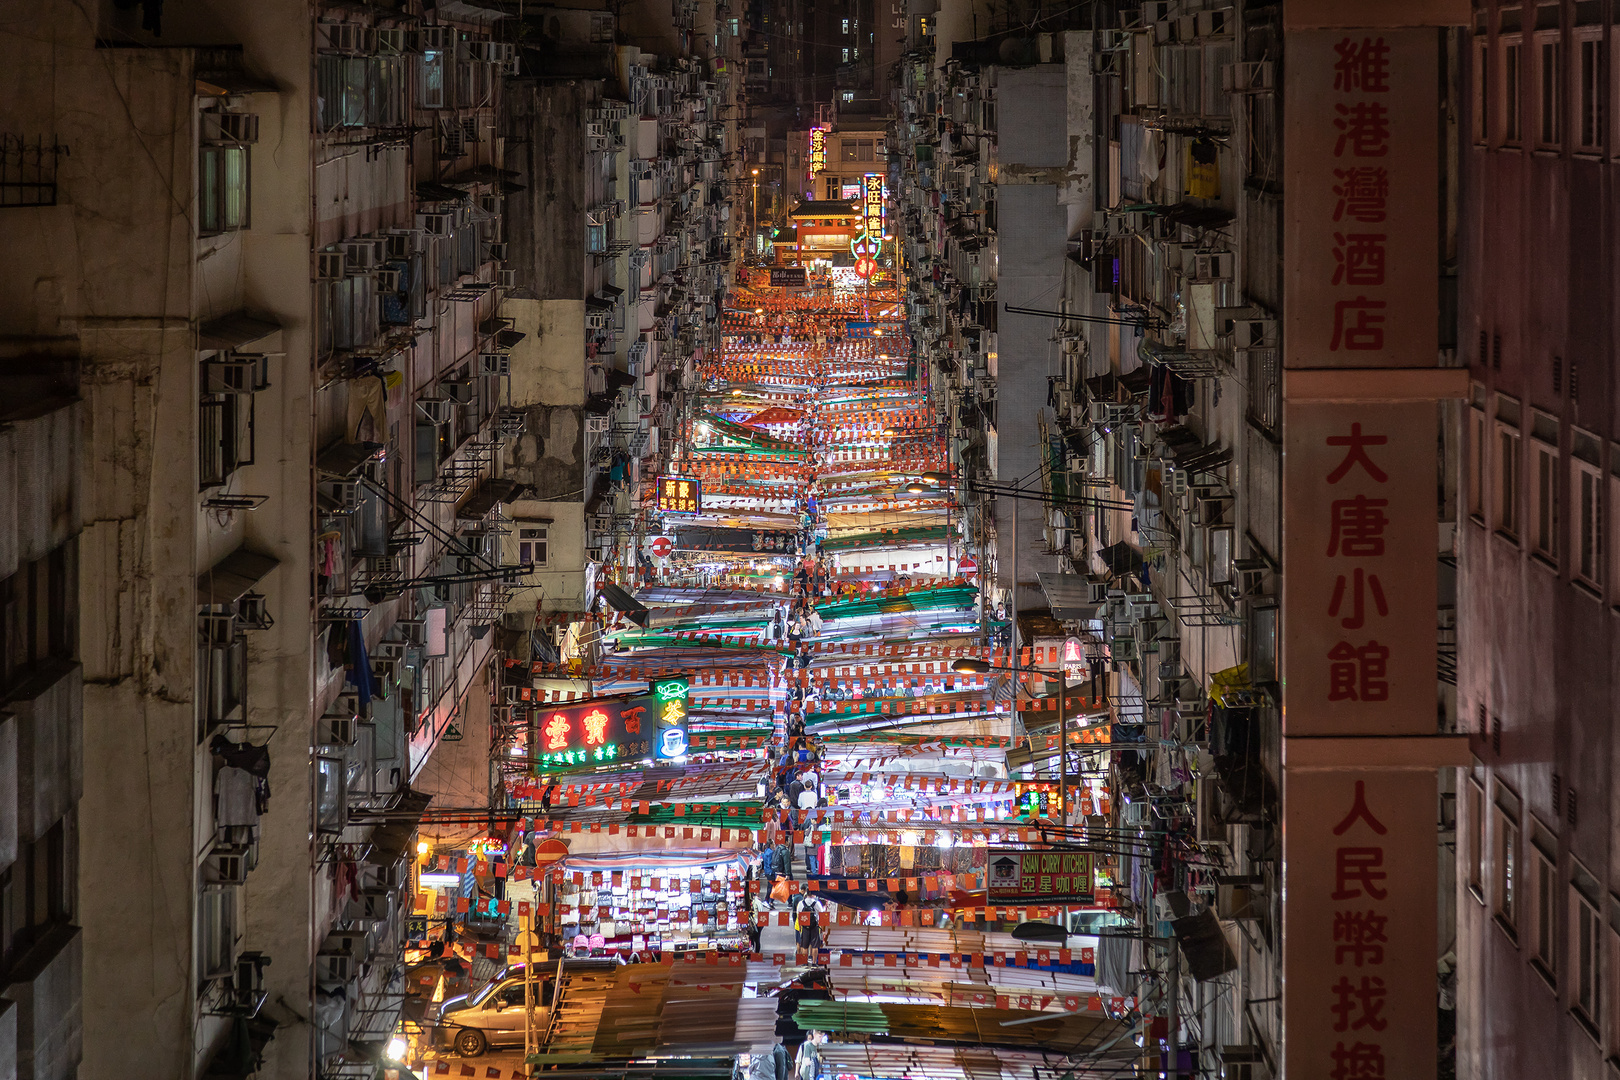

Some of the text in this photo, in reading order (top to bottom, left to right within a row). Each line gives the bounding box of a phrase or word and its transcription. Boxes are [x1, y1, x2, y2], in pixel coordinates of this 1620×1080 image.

[867, 177, 881, 230] 永旺麻雀
[1329, 36, 1391, 352] 維港灣酒店
[1326, 422, 1390, 702] 大唐小館
[1021, 854, 1088, 874] ASIAN CURRY KITCHEN
[1021, 875, 1088, 894] 亞星咖喱
[1329, 780, 1388, 1080] 人民幣找換
